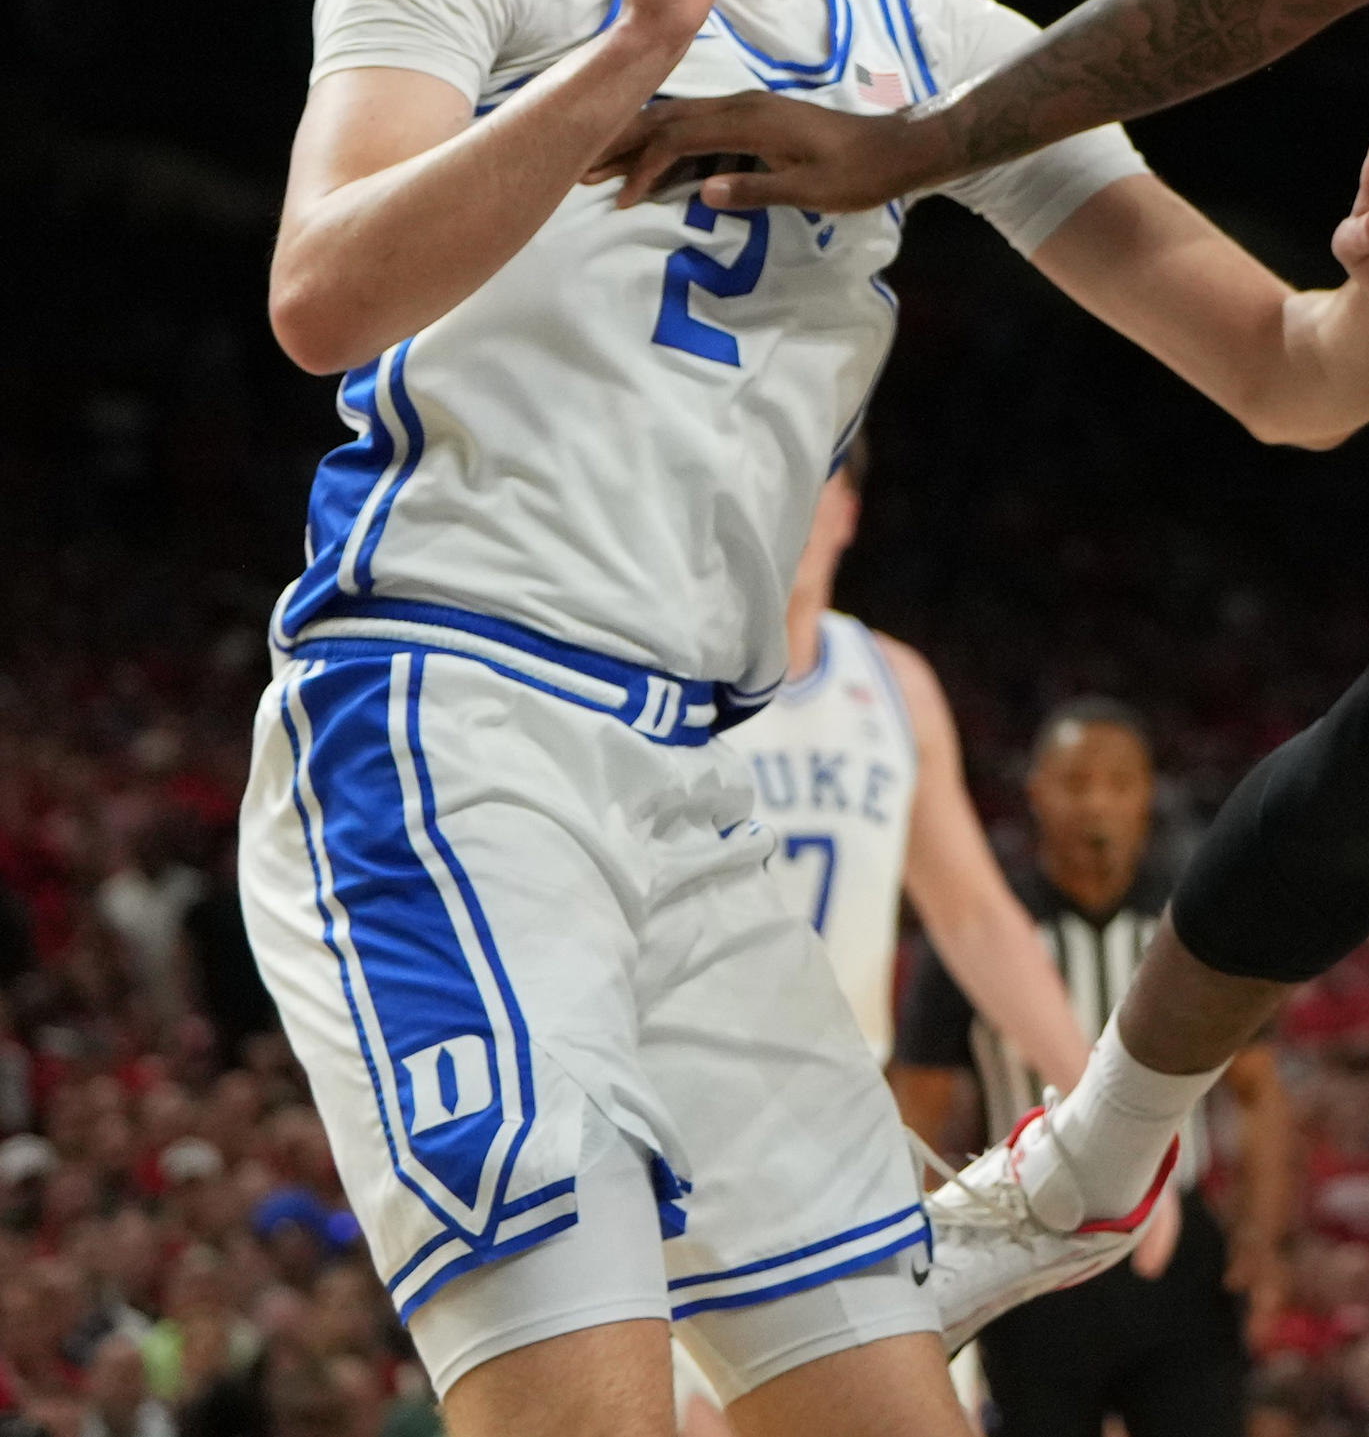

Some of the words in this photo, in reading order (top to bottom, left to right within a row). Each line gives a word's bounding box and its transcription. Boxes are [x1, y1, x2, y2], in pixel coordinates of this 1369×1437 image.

[651, 190, 770, 368] 2
[632, 675, 683, 738] D
[751, 749, 897, 826] UKE
[783, 834, 838, 937] 7
